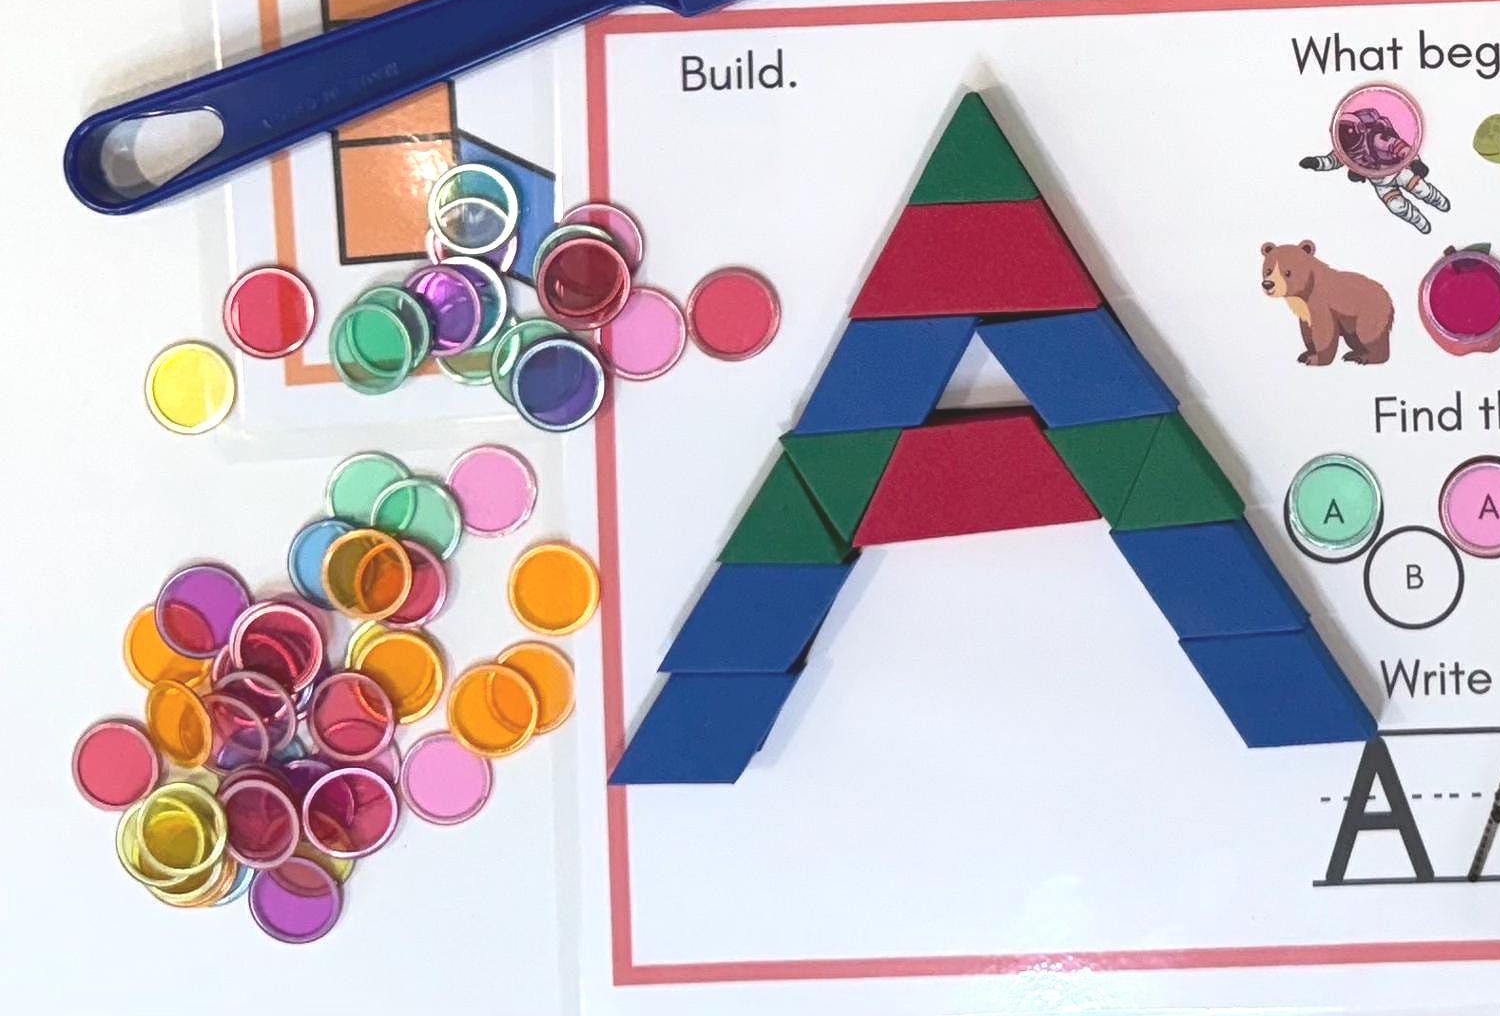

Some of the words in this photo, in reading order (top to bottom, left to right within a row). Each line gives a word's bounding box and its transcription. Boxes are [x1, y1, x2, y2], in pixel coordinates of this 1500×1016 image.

[682, 49, 796, 92] Build.
[1291, 33, 1403, 75] What
[1375, 391, 1462, 433] Find
[1324, 499, 1344, 524] A
[1479, 494, 1499, 519] A
[1406, 564, 1424, 589] B
[1380, 659, 1492, 698] Write
[1325, 735, 1435, 883] A
